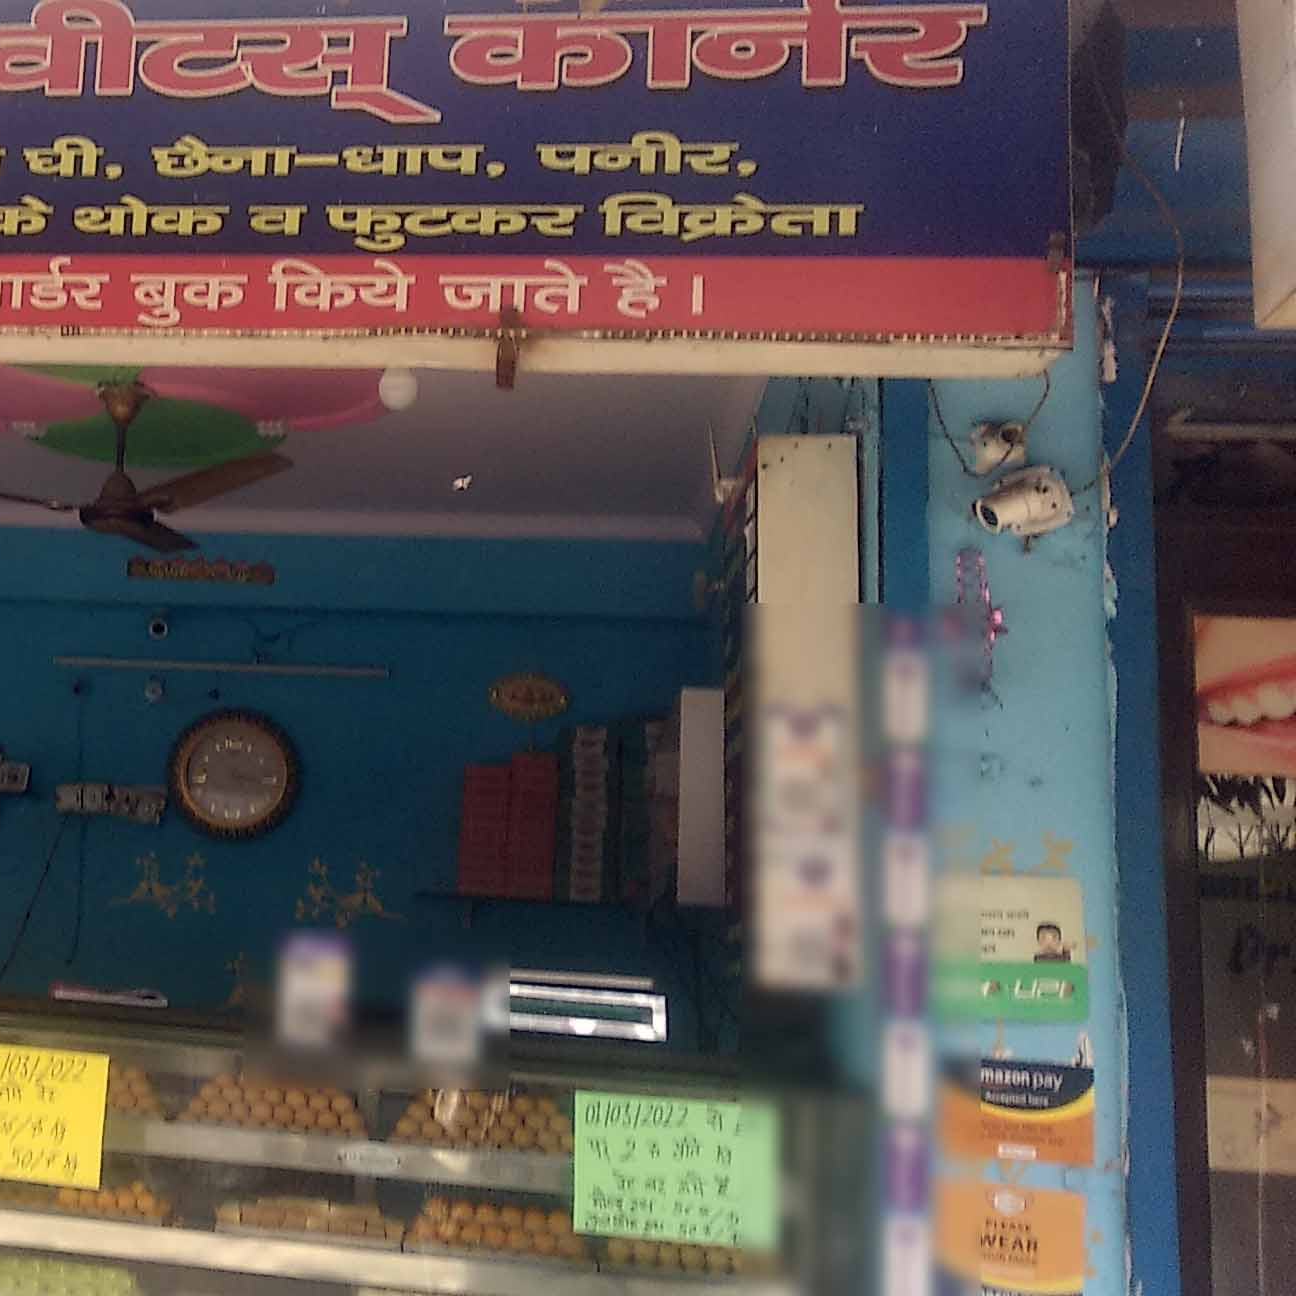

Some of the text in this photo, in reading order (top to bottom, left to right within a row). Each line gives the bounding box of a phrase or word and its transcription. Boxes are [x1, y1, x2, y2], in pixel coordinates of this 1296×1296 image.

[73, 194, 231, 237] थोक
[248, 204, 308, 236] व
[325, 204, 584, 253] फुटकर
[599, 192, 865, 242] विक्रेता
[129, 272, 249, 328] बुक
[267, 257, 416, 313] किये
[438, 257, 589, 314] जाते
[603, 258, 668, 318] है
[1032, 1070, 1064, 1093] pay
